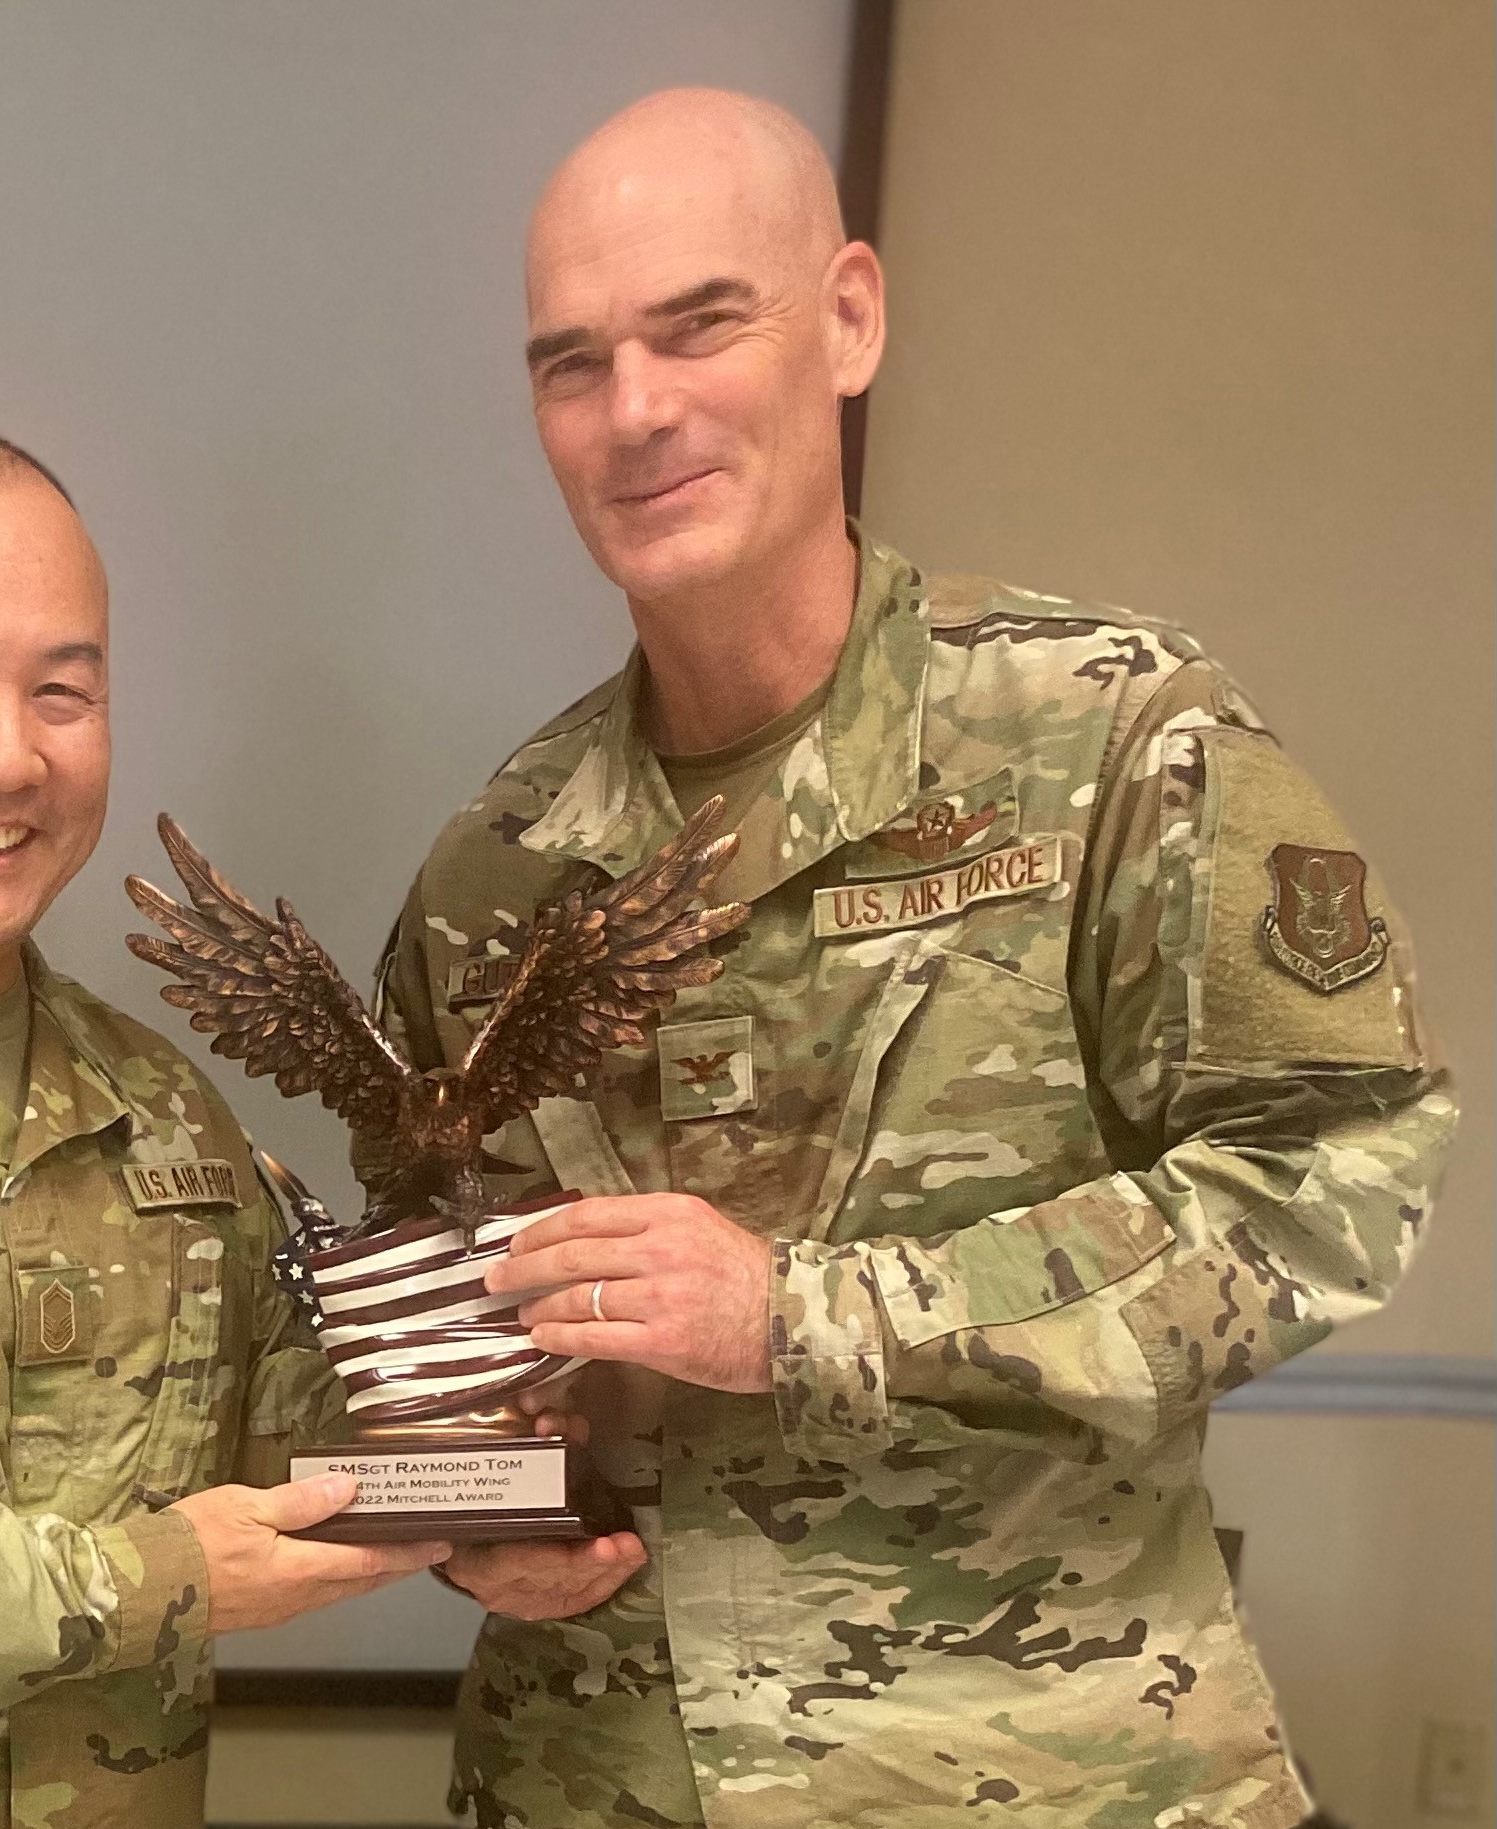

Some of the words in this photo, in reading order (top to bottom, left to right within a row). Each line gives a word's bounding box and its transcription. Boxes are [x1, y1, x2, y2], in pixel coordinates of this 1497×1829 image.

[832, 886, 890, 929] U.S.
[898, 878, 944, 920] AIR
[956, 846, 1044, 905] FORCE
[134, 1169, 172, 1200] U.S.
[171, 1166, 204, 1197] AIR
[200, 1165, 236, 1196] FOR
[396, 1461, 480, 1474] RAYMOND
[484, 1458, 522, 1471] TOM
[356, 1481, 381, 1490] 4TH
[384, 1480, 406, 1489] AIR
[410, 1479, 470, 1488] MOBILITY
[473, 1477, 511, 1486] WING
[387, 1494, 452, 1504] MITCHELL
[455, 1493, 504, 1502] AWARD
